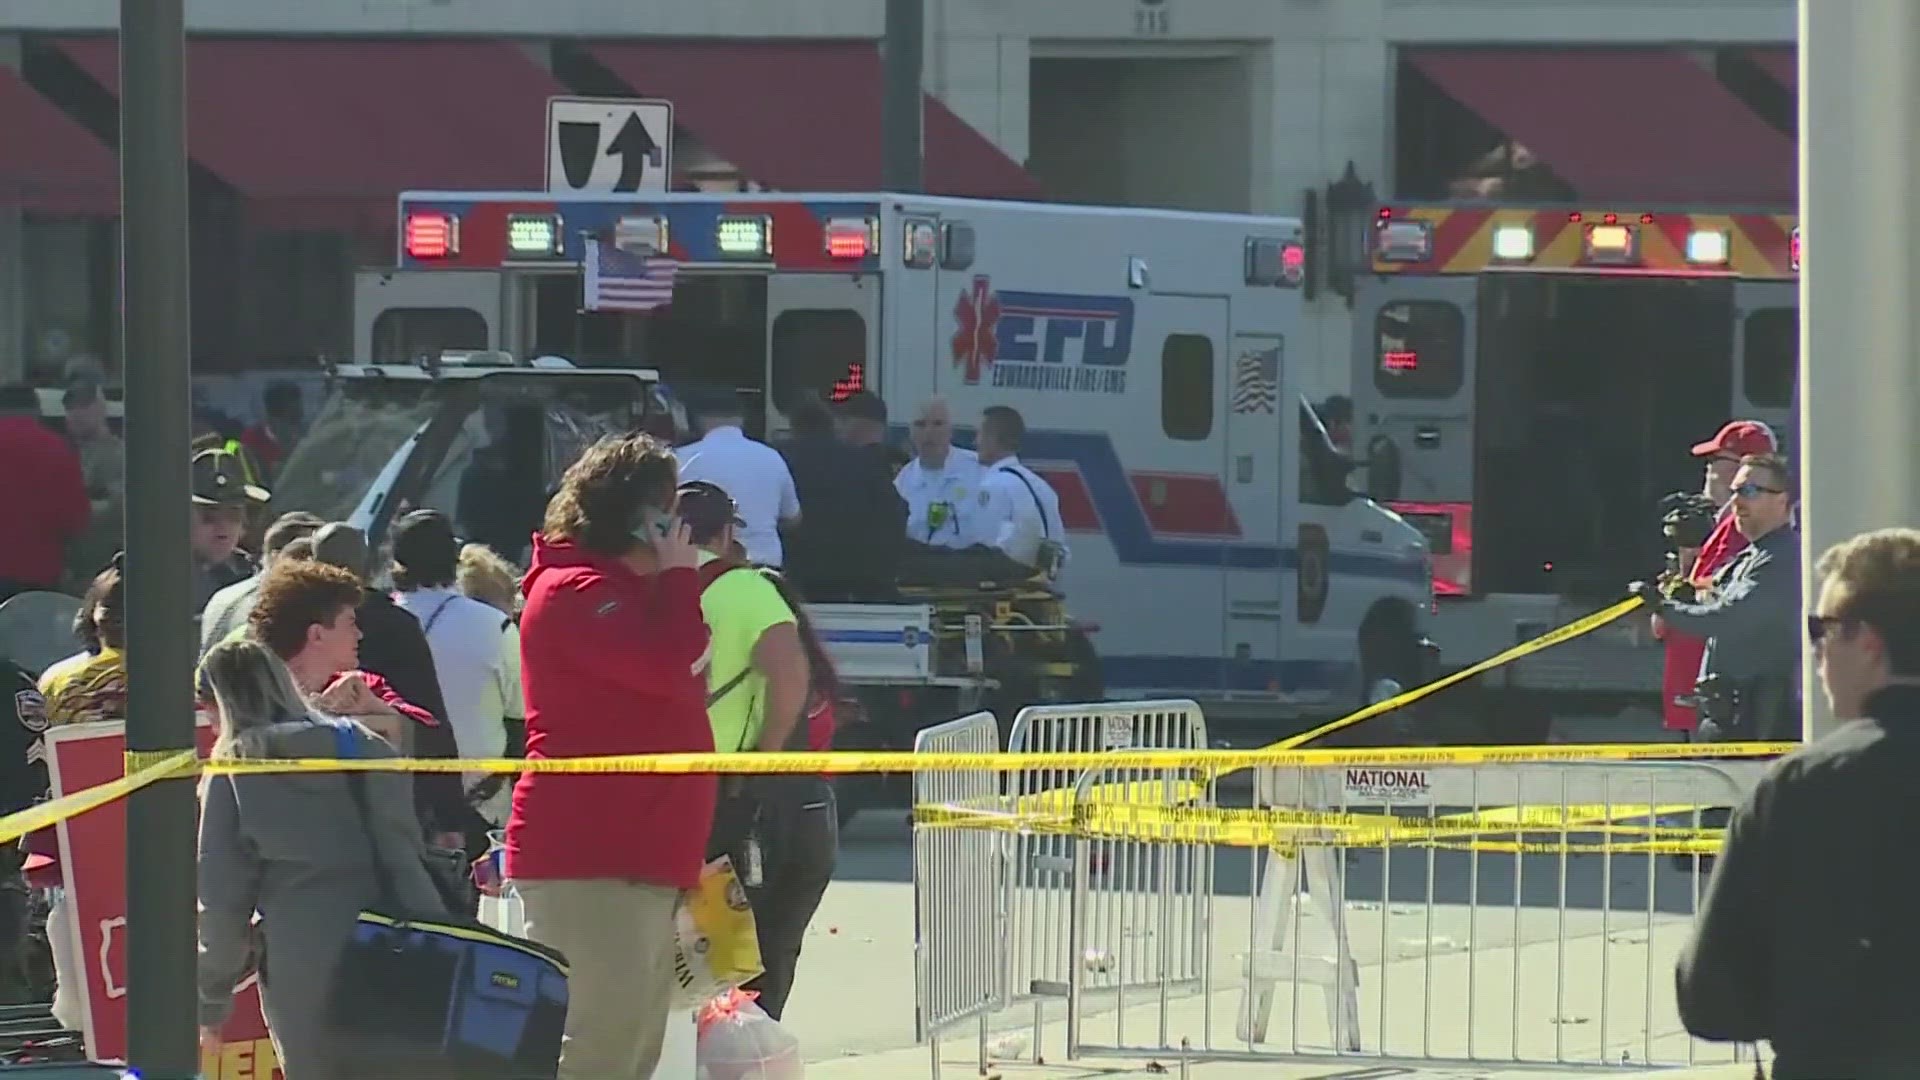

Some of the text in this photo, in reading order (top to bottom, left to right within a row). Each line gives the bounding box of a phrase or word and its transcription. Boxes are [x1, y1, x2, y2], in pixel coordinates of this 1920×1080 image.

[994, 290, 1135, 365] EFD
[992, 364, 1127, 394] EDWARDSVILLE FIRE/EMS
[1346, 769, 1431, 788] NATIONAL
